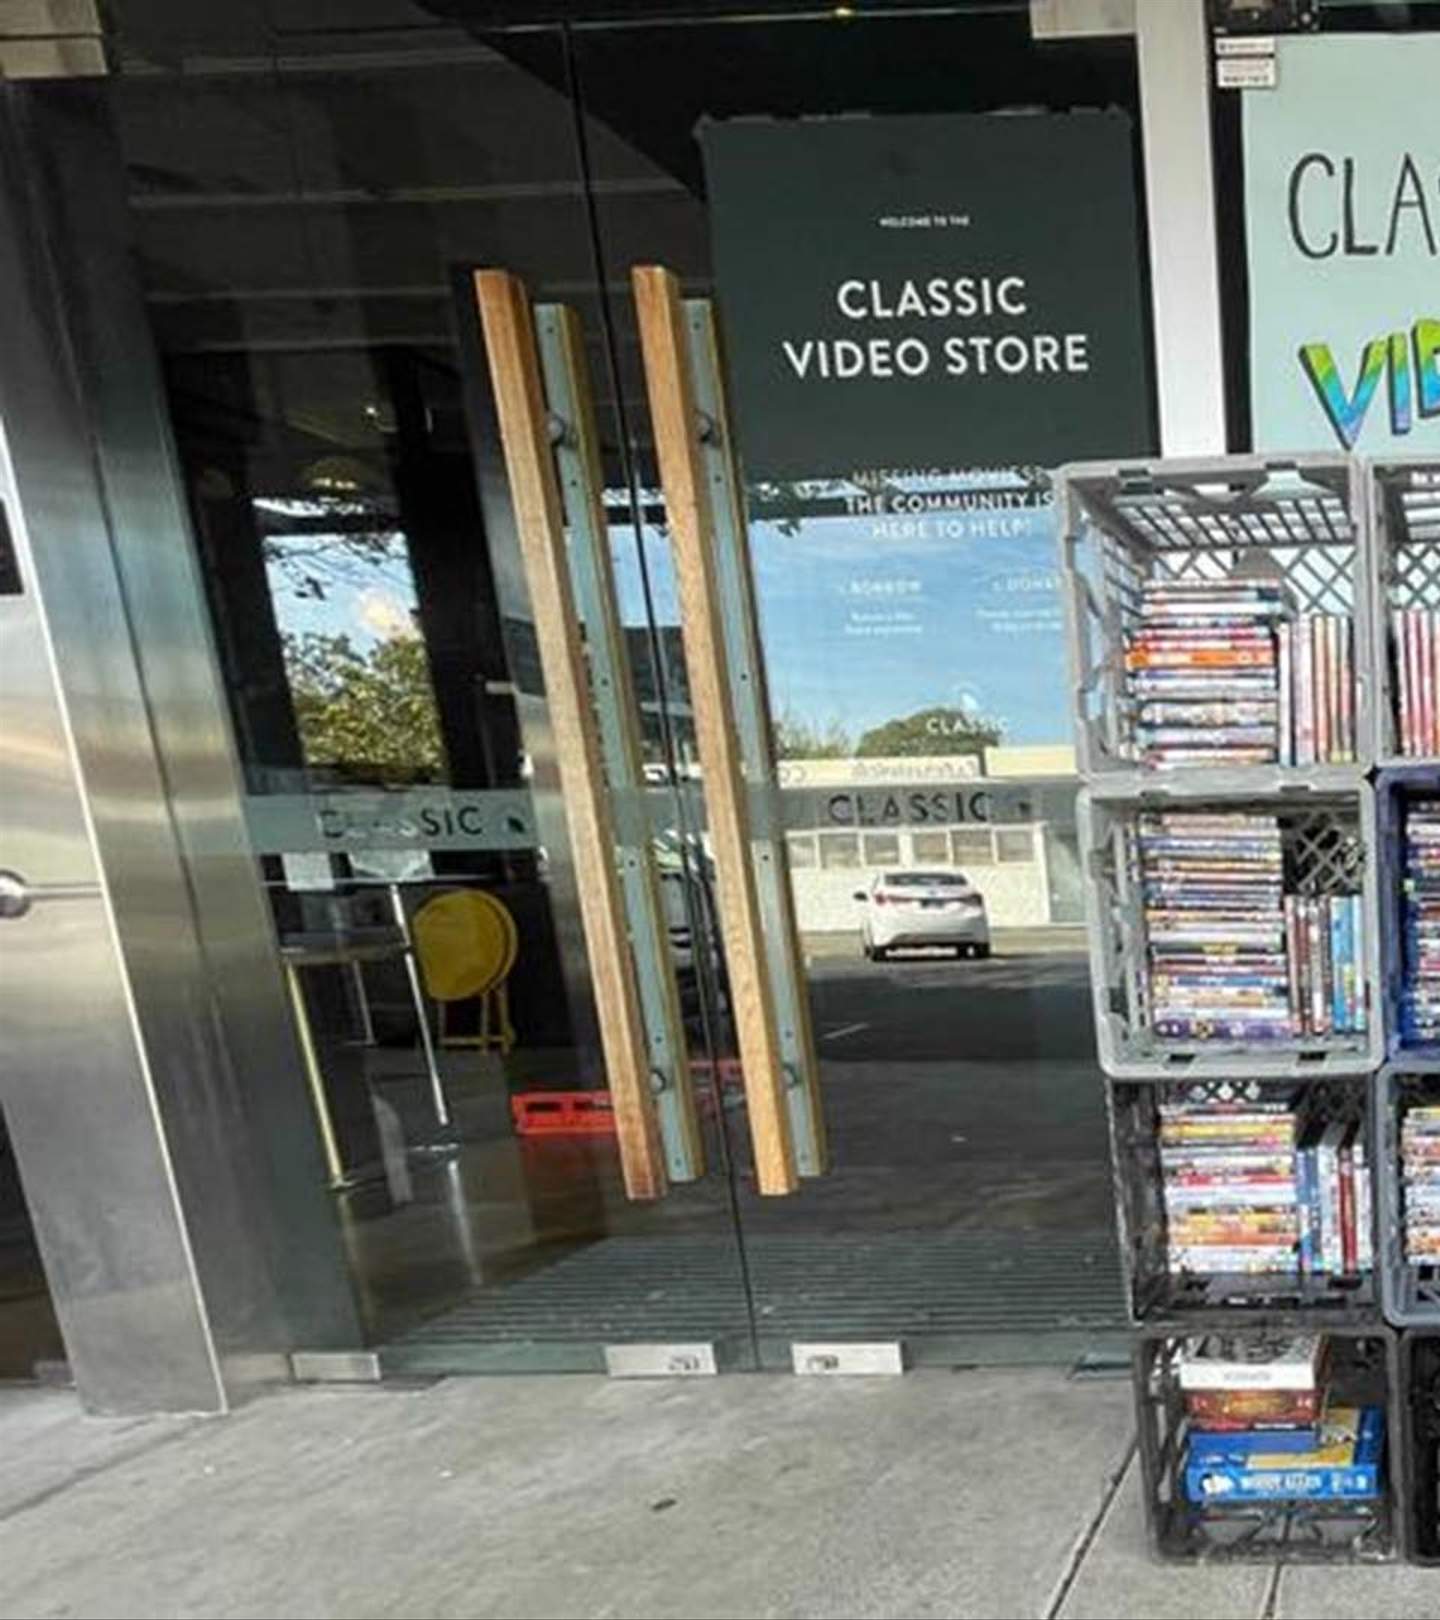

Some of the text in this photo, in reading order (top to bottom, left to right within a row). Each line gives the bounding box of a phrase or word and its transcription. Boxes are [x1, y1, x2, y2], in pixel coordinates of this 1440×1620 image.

[879, 214, 970, 228] WELCOME TO THE
[836, 277, 1028, 319] CLASSIC
[782, 334, 1091, 379] VIDEO STORE
[853, 466, 941, 489] MISSING
[846, 491, 1055, 515] THE COMMUNITY IS
[872, 520, 928, 539] HERE
[936, 519, 965, 538] TO
[925, 715, 1009, 735] CLASSIC
[828, 791, 991, 823] CLASSIC
